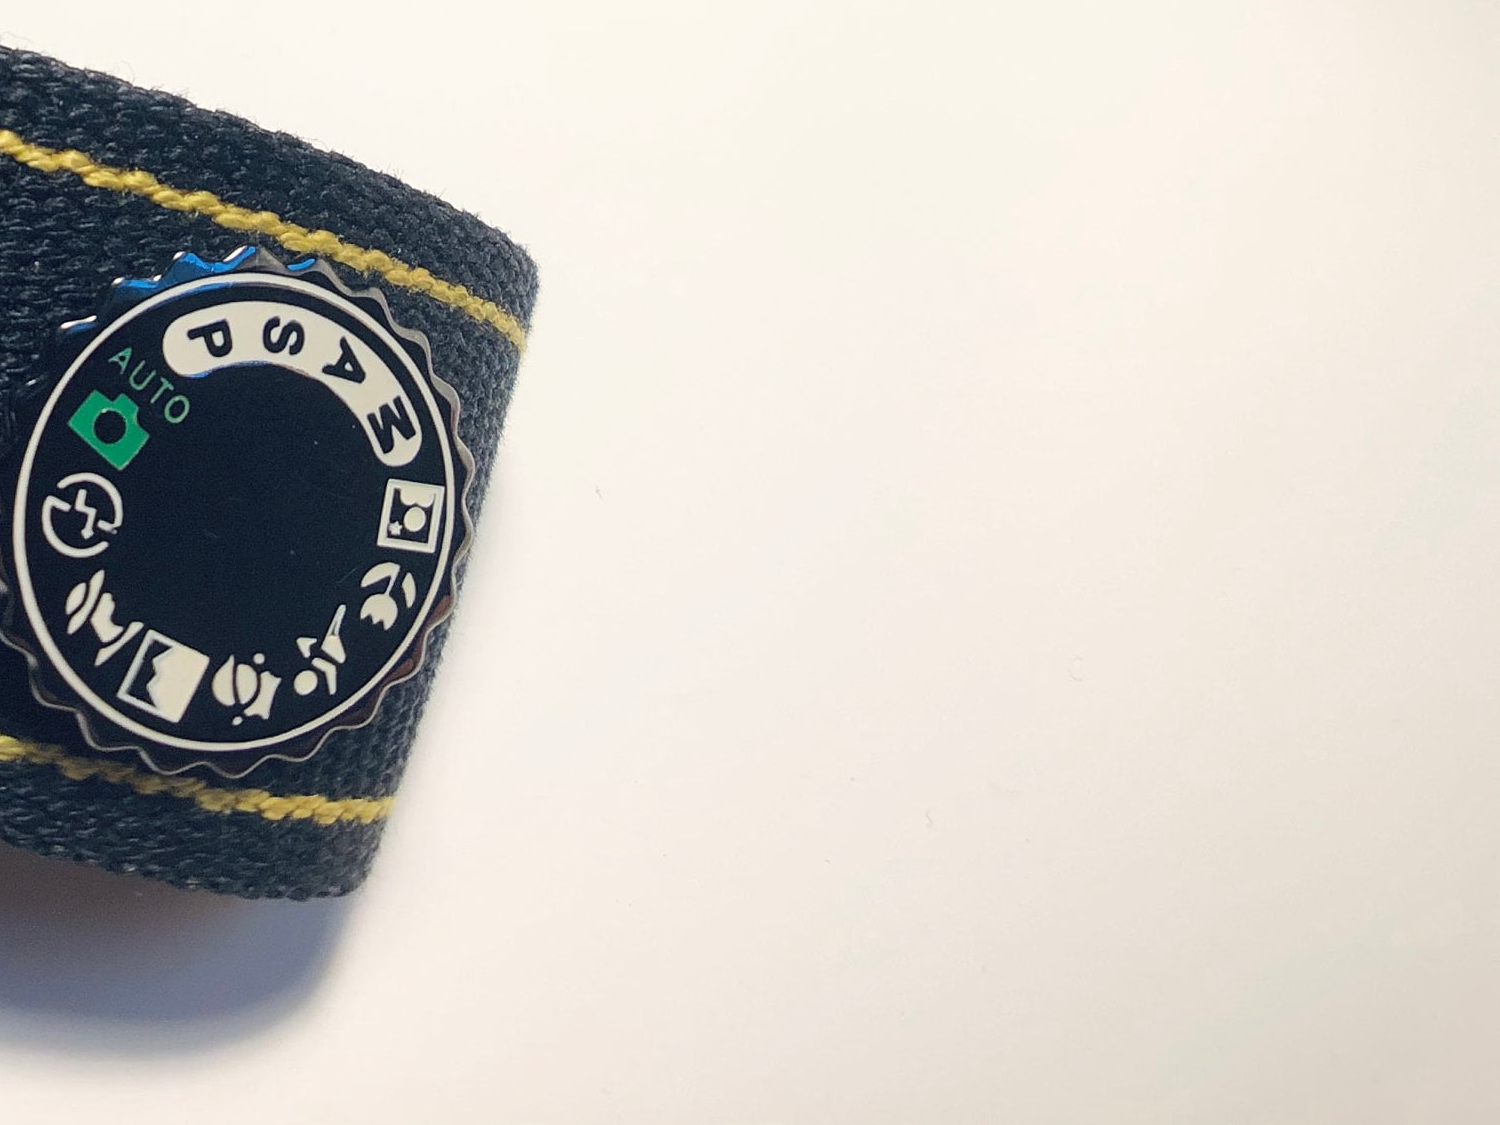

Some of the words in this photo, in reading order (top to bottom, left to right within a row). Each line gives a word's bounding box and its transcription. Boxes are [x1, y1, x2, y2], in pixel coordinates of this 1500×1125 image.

[108, 346, 190, 424] AUTO
[187, 319, 233, 358] P
[262, 316, 306, 356] S
[322, 337, 366, 384] A
[366, 396, 417, 454] M
